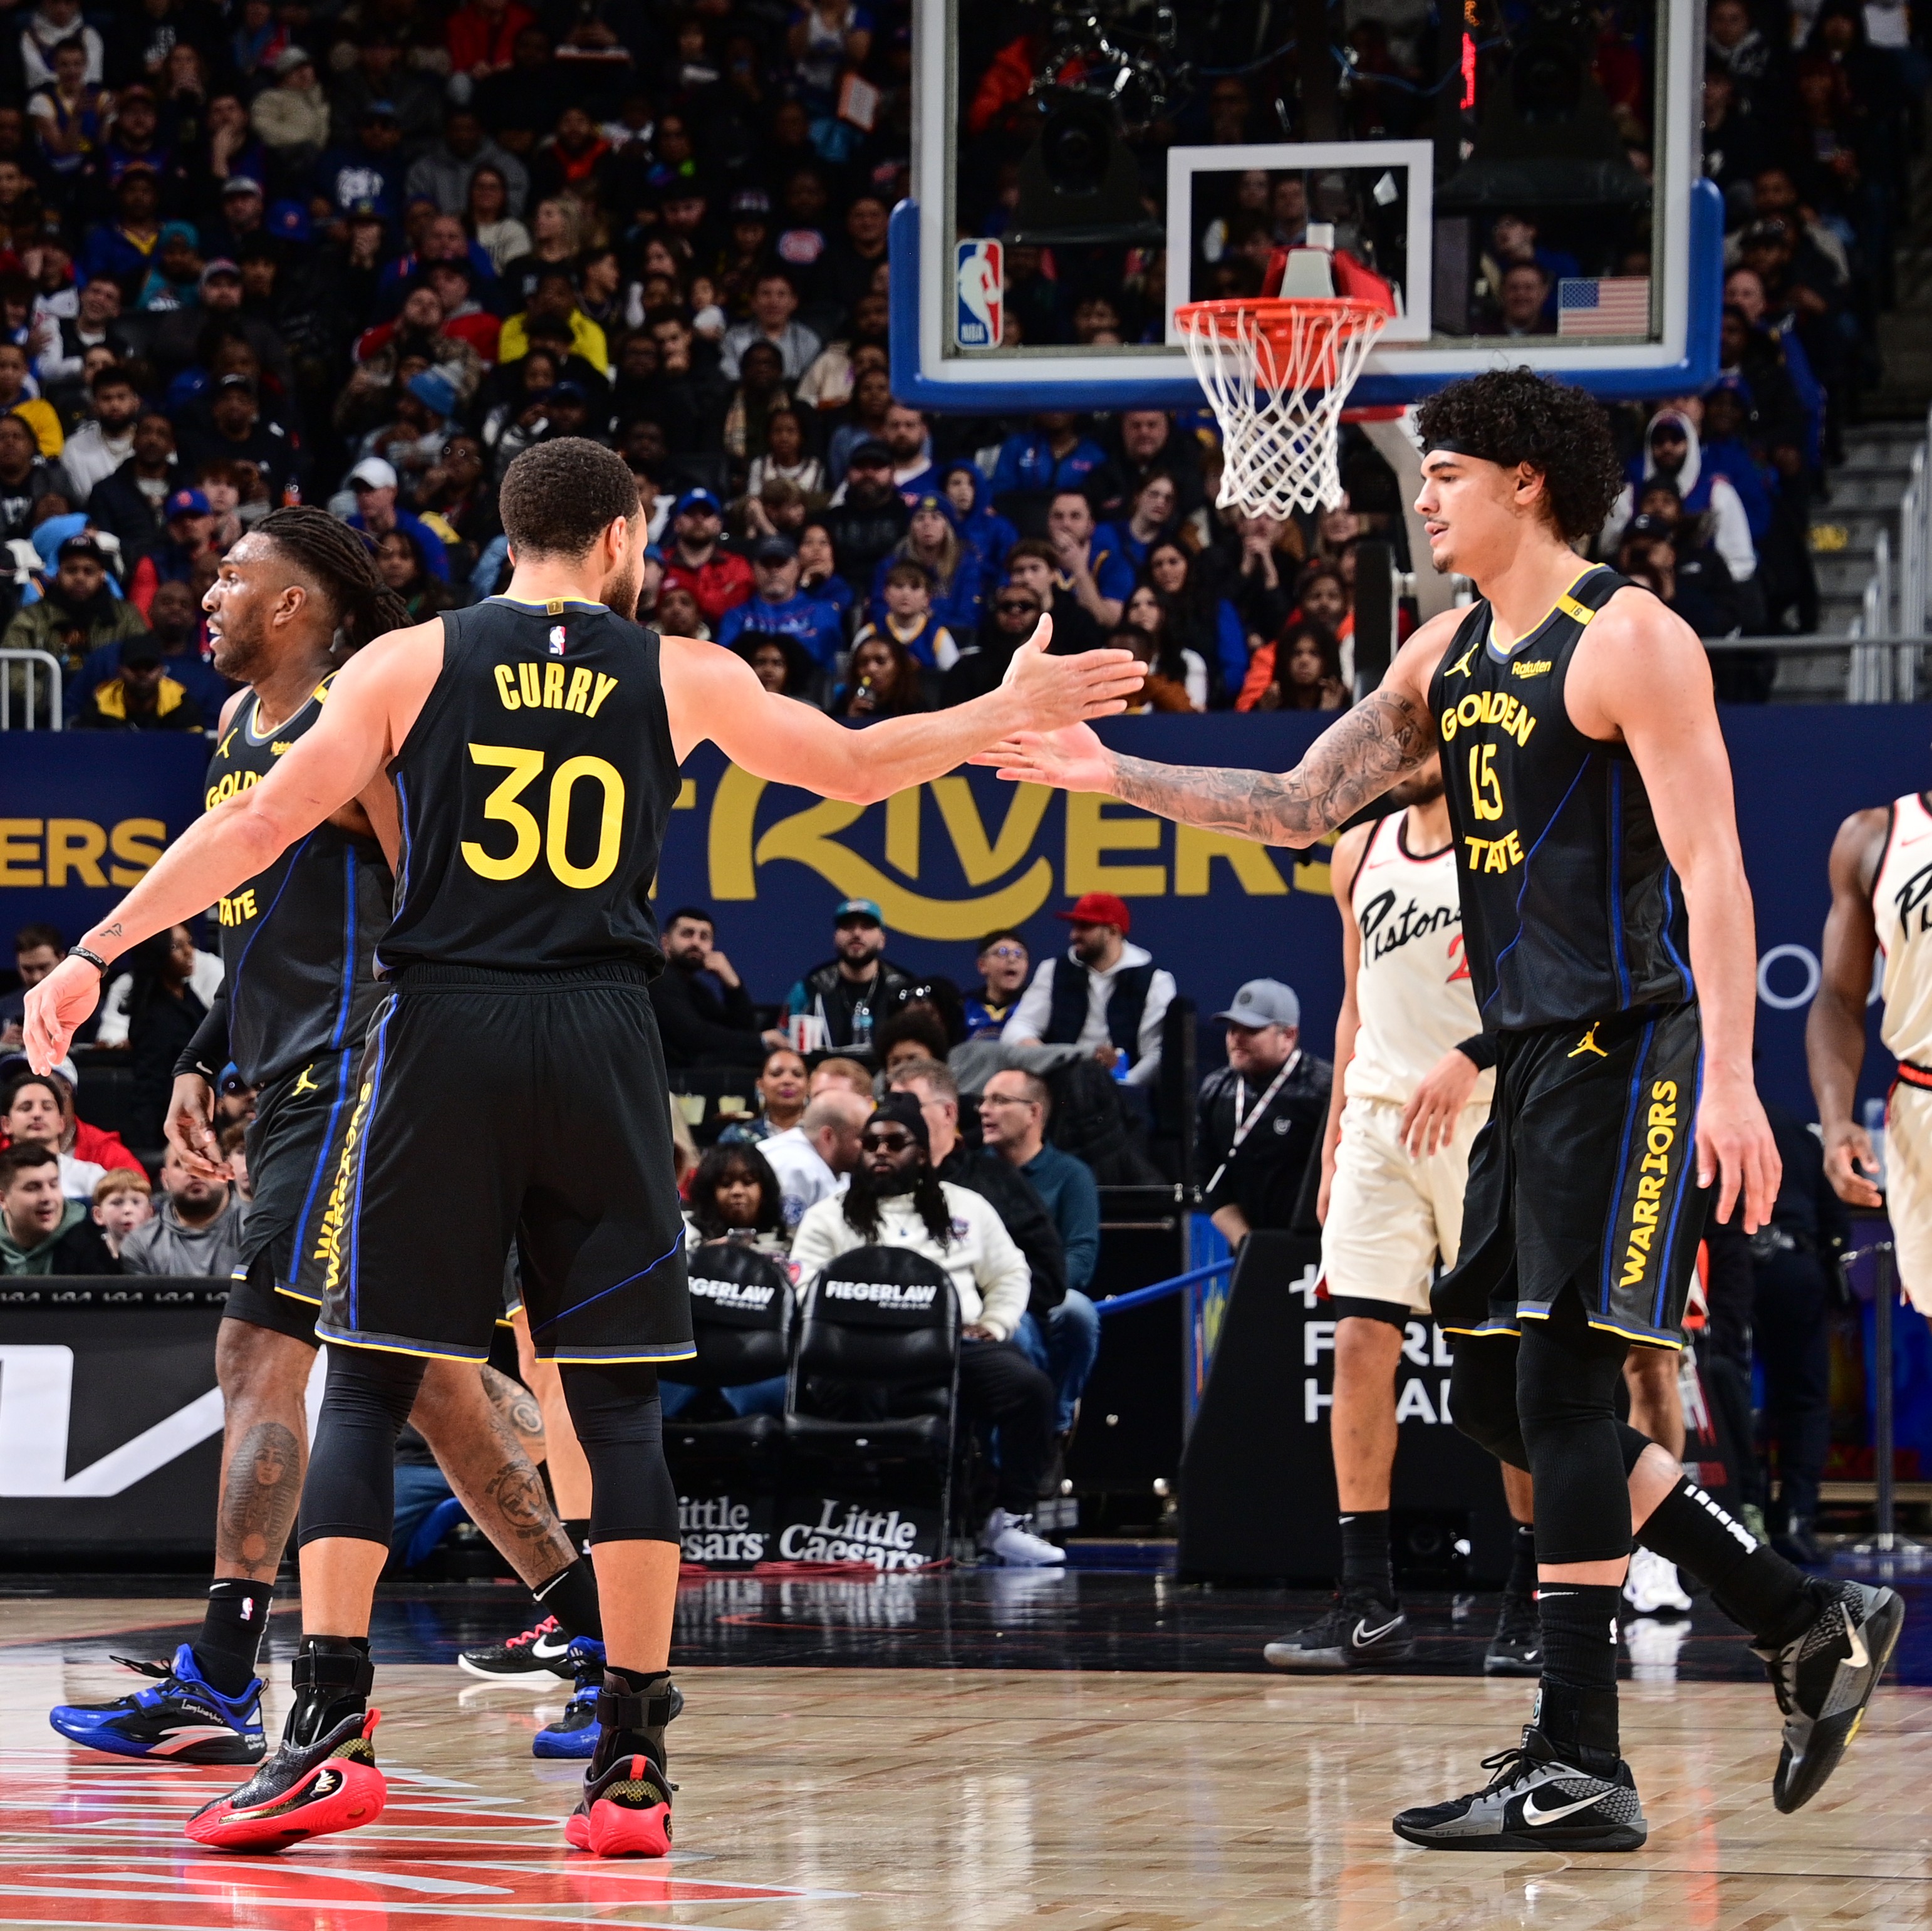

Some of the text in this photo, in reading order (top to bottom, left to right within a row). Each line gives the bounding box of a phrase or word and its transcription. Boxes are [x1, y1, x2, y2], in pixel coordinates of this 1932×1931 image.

[494, 662, 618, 718] CURRY
[1512, 660, 1552, 675] Rakuten
[1441, 692, 1536, 747] GOLDEN
[206, 771, 263, 812] GOLD
[1470, 744, 1503, 821] 15
[461, 743, 625, 889] 30
[1619, 1081, 1677, 1288] WARRIORS
[826, 1280, 937, 1304] FIEGERLAW
[678, 1496, 749, 1531] ittle
[814, 1498, 917, 1549] Little
[779, 1523, 926, 1571] Caesars
